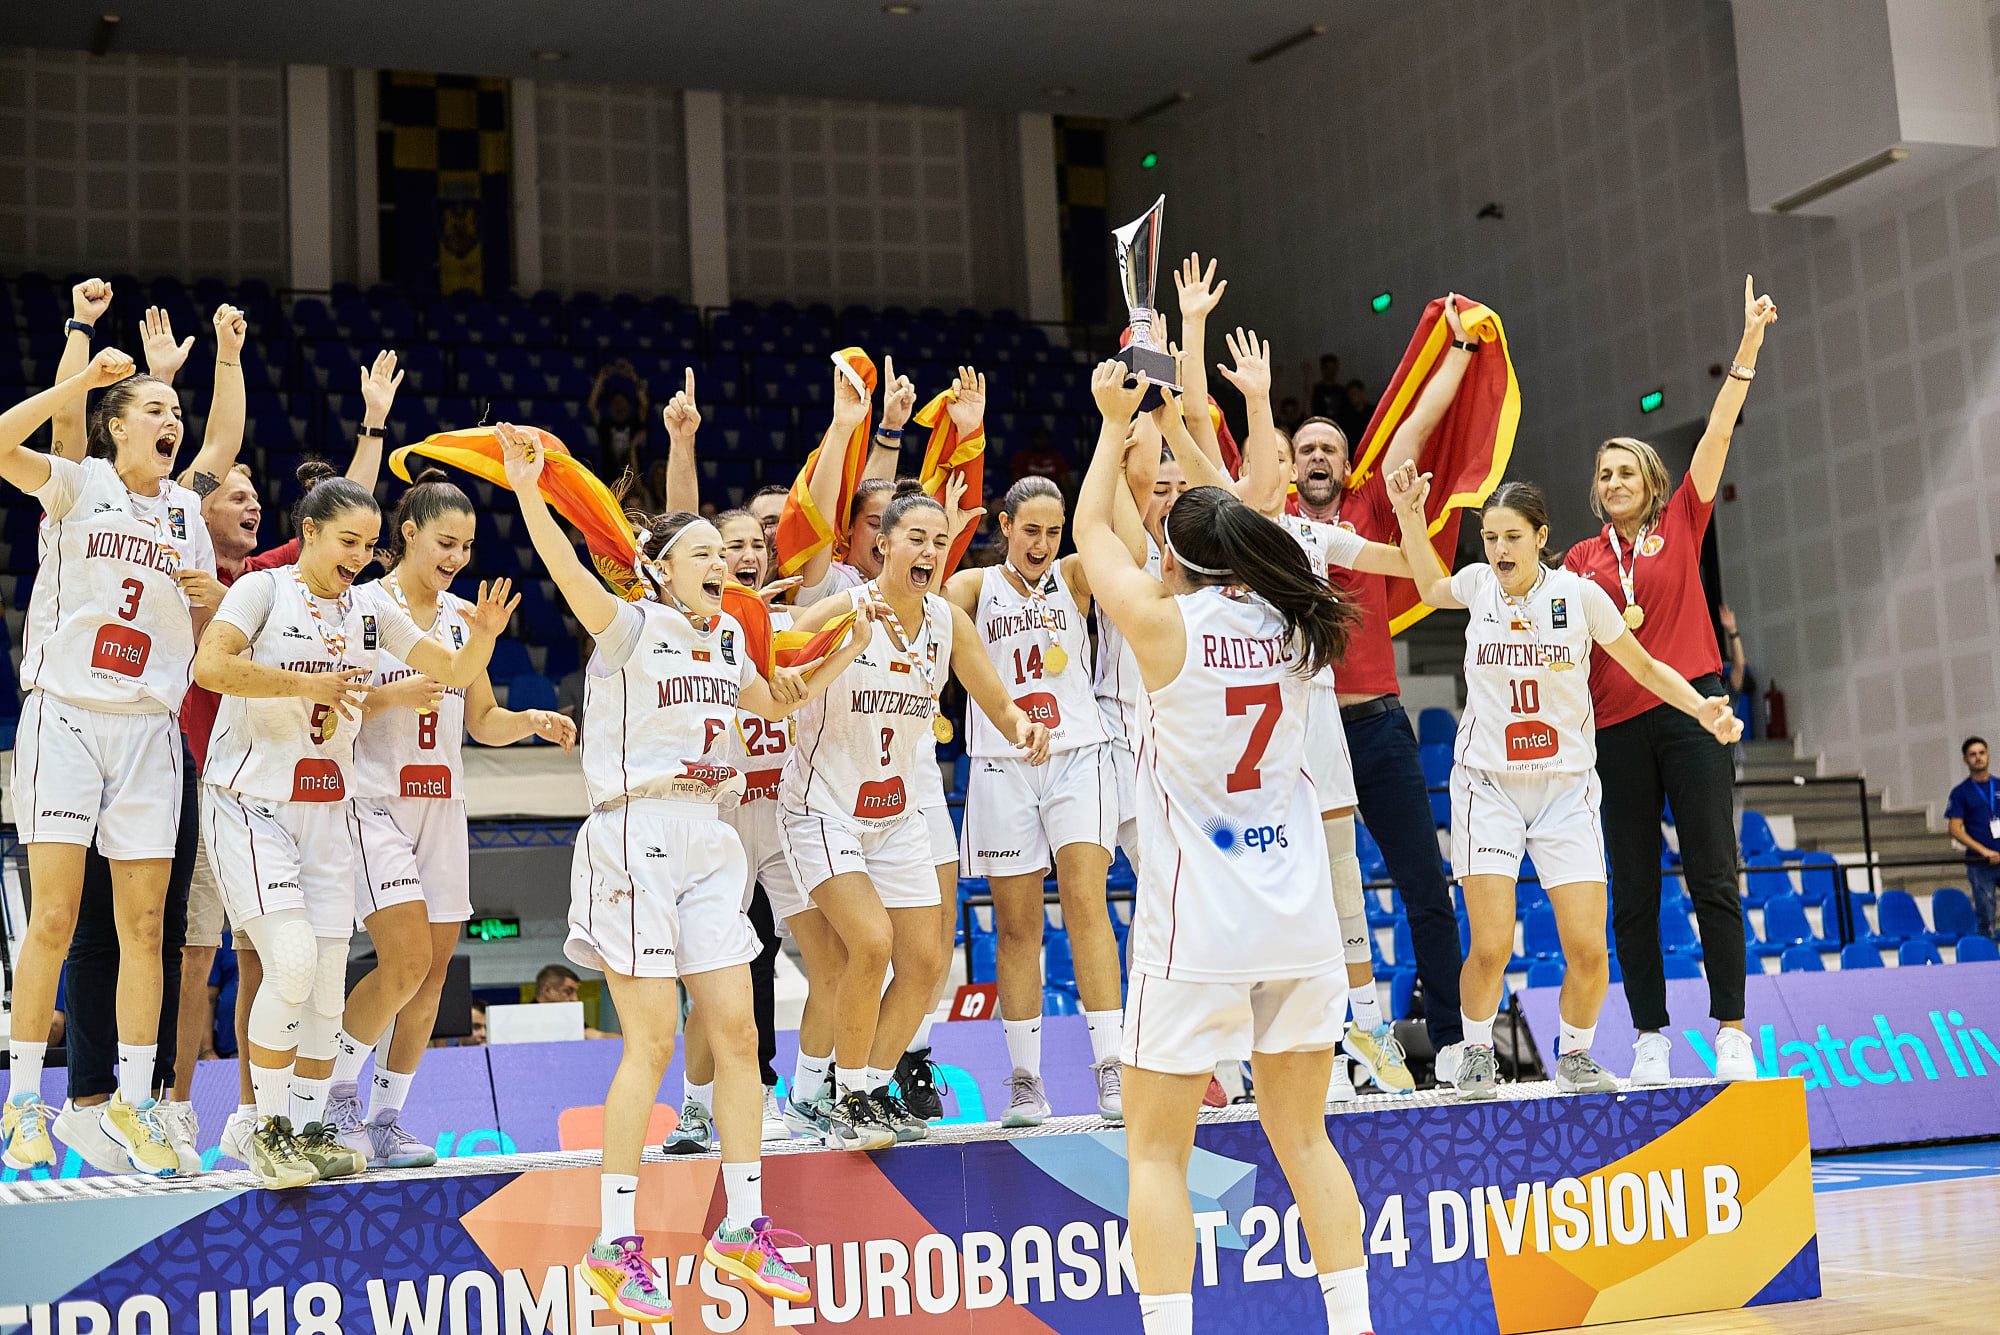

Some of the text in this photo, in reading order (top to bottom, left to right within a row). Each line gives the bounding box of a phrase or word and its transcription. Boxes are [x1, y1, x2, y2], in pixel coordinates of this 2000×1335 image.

[119, 577, 145, 622] 3
[282, 631, 313, 641] DHIKA
[101, 638, 145, 666] m:tel
[1013, 644, 1044, 685] 14
[851, 690, 932, 719] MONTENEGRO
[1025, 702, 1054, 720] :tel
[1510, 680, 1540, 714] 10
[310, 703, 333, 744] 5
[418, 711, 439, 749] 8
[743, 717, 787, 756] 25
[1225, 682, 1283, 793] 7
[1512, 729, 1552, 749] m:tel
[300, 771, 340, 790] m:tel
[407, 776, 446, 795] m:tel
[747, 782, 779, 800] m:t
[863, 786, 903, 808] m:tel
[41, 810, 91, 823] BEMAX
[977, 850, 1021, 858] BEMAX
[960, 992, 986, 1018] 5
[1683, 1014, 1939, 1090] Watch
[774, 1210, 1229, 1327] EUROBASKT
[1242, 1194, 1411, 1284] 204
[1429, 1168, 1689, 1264] DIVISION
[1703, 1164, 1743, 1236] B
